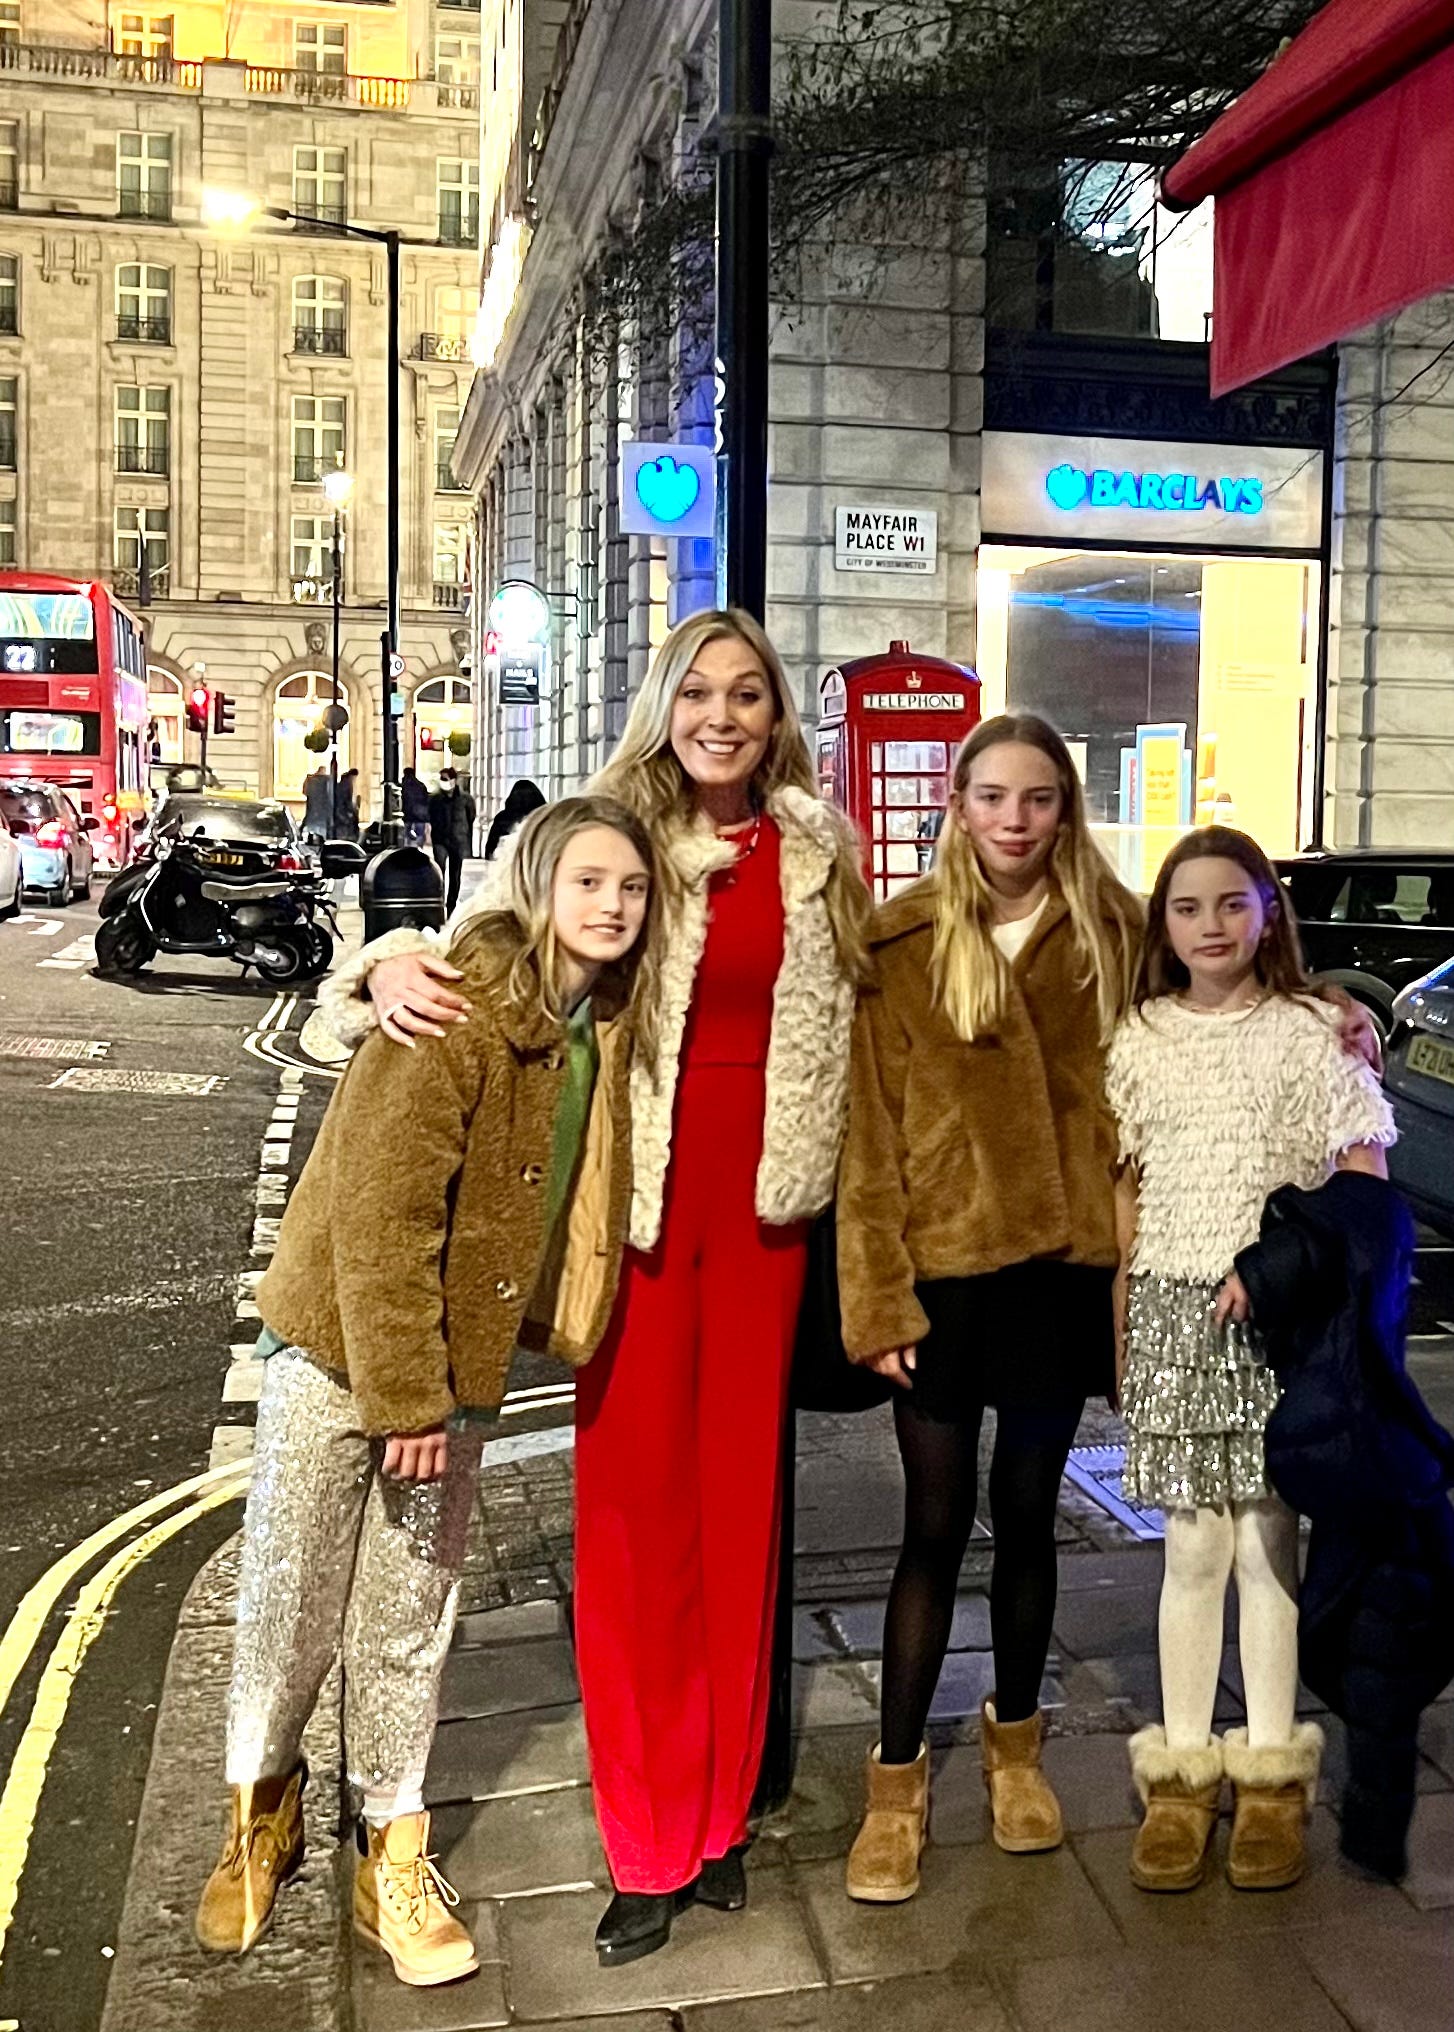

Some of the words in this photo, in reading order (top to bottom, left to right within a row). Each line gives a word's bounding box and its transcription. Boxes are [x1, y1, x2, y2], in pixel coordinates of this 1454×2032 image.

[1090, 469, 1263, 514] BARCLAYS
[846, 513, 917, 532] MAYFAIR
[846, 532, 895, 550] PLACE
[903, 535, 924, 551] W1
[846, 558, 862, 566] CITY
[864, 559, 873, 567] OF
[876, 560, 927, 570] WESTMINSTER
[867, 694, 961, 708] TELEPHONE
